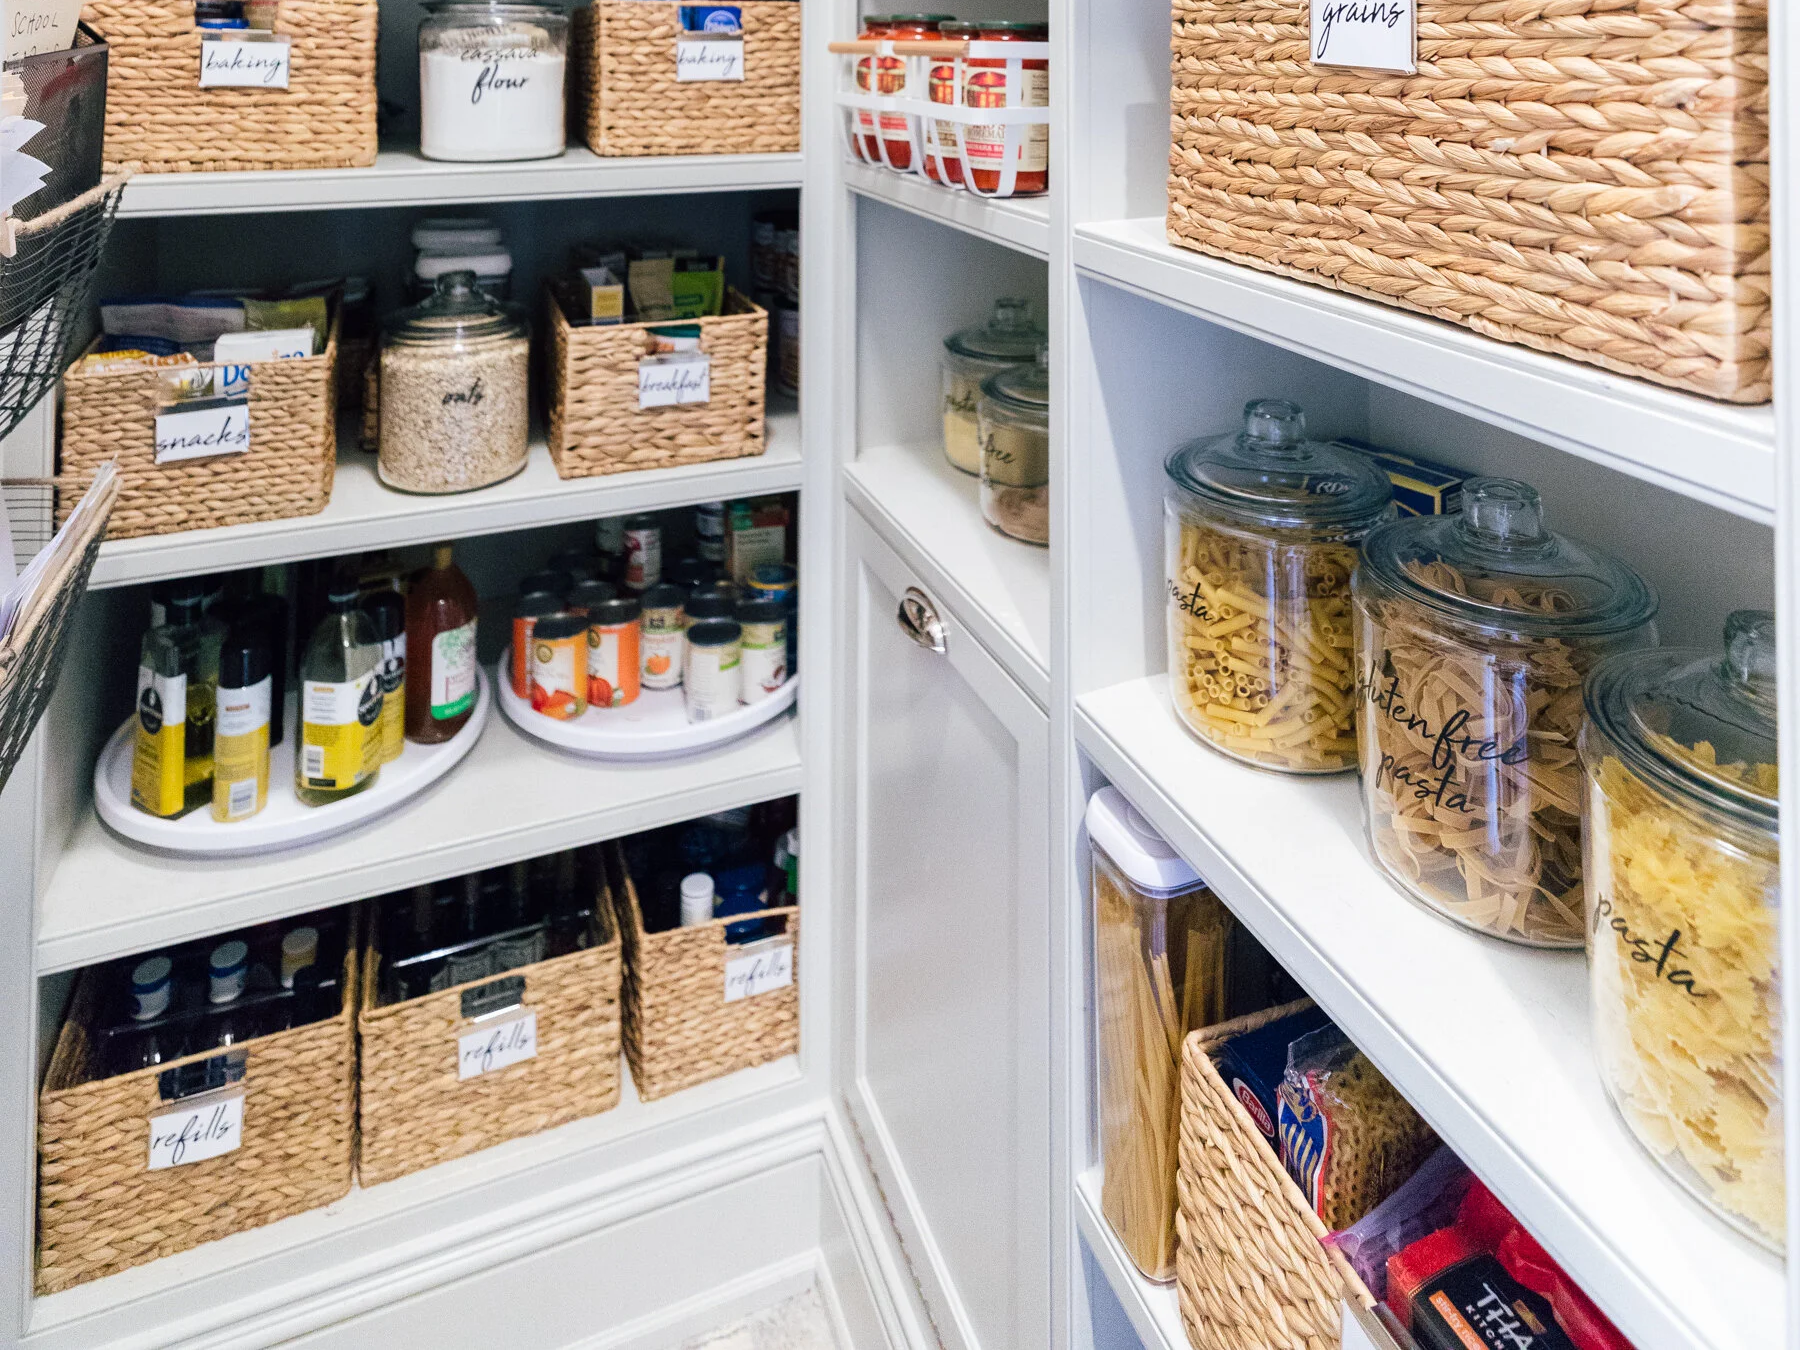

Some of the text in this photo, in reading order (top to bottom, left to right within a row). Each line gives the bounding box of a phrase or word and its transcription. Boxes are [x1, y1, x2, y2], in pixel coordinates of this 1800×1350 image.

[12, 11, 58, 38] SCHOOL
[205, 46, 284, 83] baking
[679, 43, 740, 76] baking
[471, 63, 530, 104] flour
[157, 415, 247, 452] snacks
[1356, 660, 1530, 771] gluten free
[1376, 751, 1475, 812] pasta
[1593, 892, 1709, 999] pasta
[463, 1022, 532, 1072] refills
[1241, 1090, 1271, 1132] Barilla
[152, 1104, 236, 1165] refills
[1477, 1282, 1534, 1350] THA
